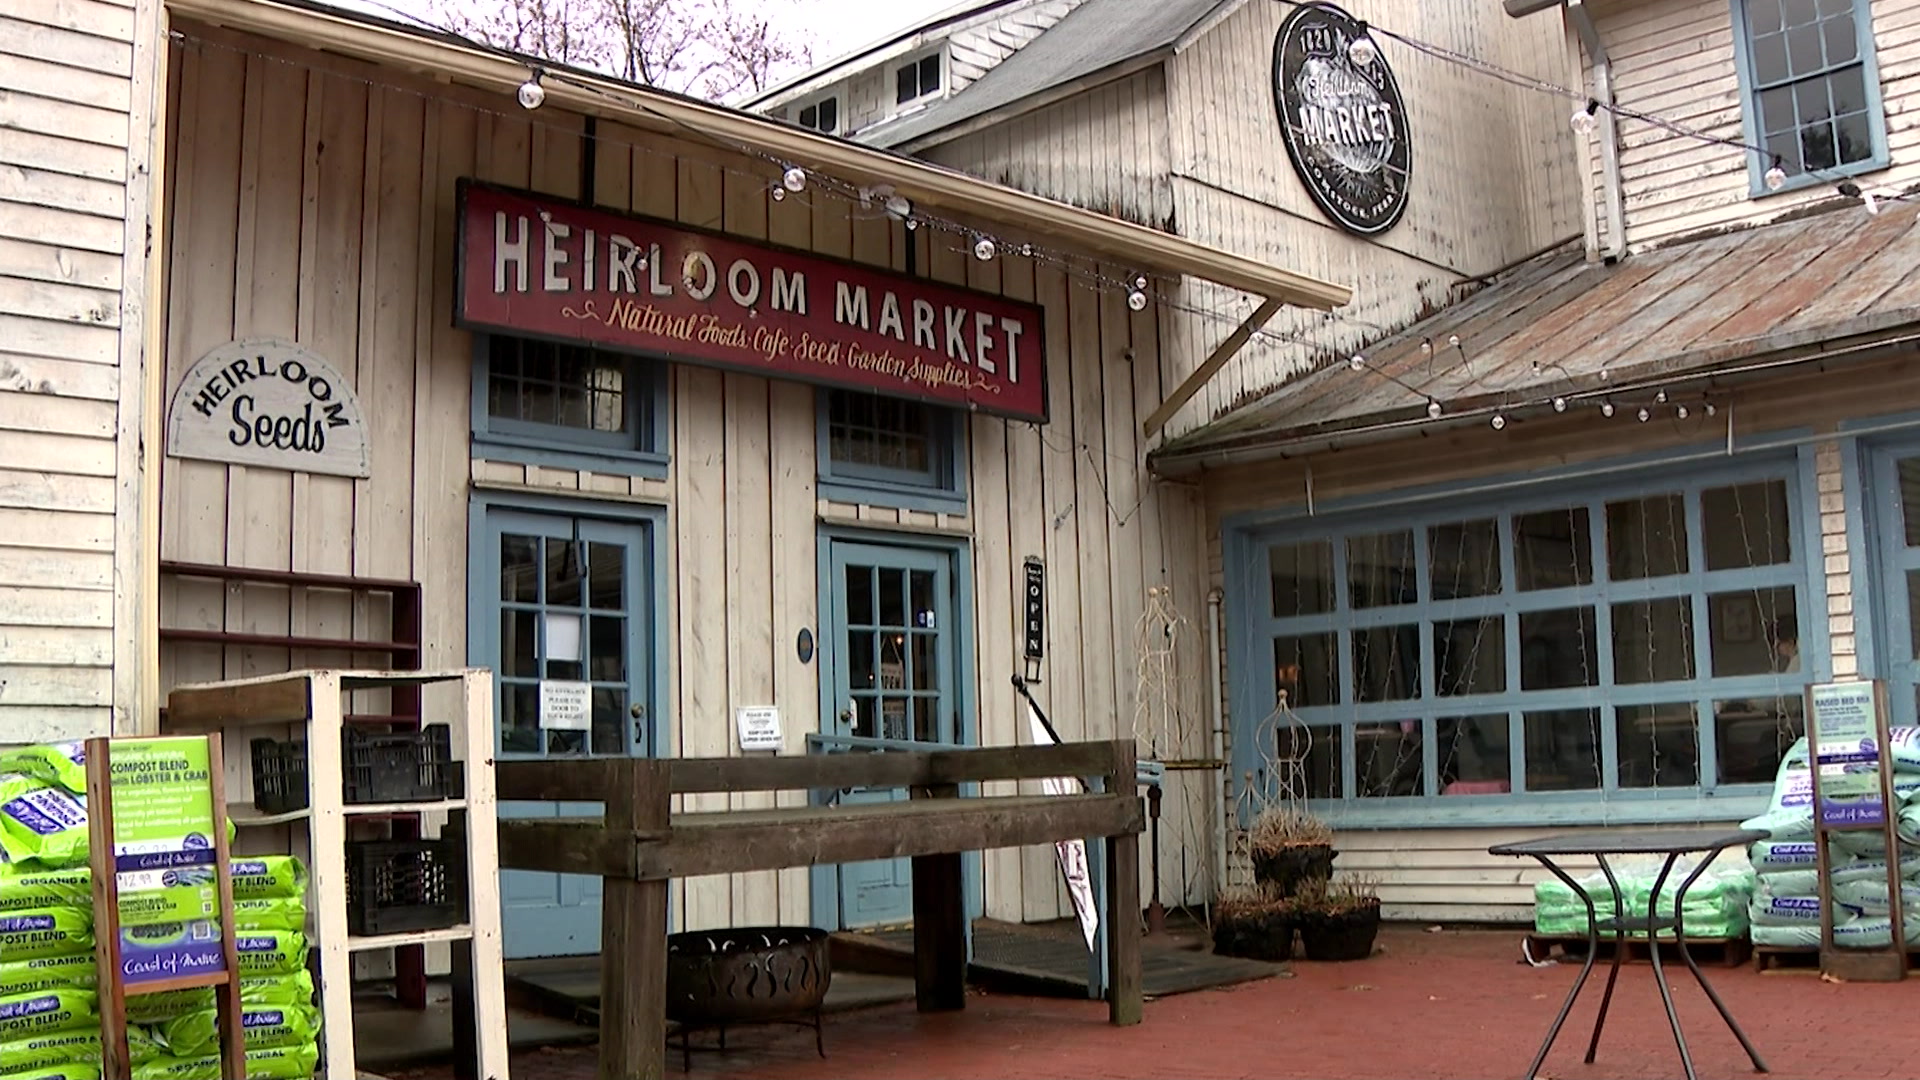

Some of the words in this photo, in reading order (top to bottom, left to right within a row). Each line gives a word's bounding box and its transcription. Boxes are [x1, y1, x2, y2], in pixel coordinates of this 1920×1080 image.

[1299, 100, 1395, 146] MARKET
[494, 210, 807, 315] HEIRLOOM
[835, 280, 1024, 384] MARKET
[604, 297, 697, 341] Natural
[192, 355, 350, 429] HEIRLOOM
[229, 394, 325, 453] Seeds
[1029, 585, 1040, 650] OPEN
[110, 761, 157, 774] COMPOST
[159, 760, 190, 771] BLEND
[131, 772, 171, 785] LOBSTER
[174, 772, 181, 782] &
[183, 769, 208, 781] CRAB
[245, 877, 277, 886] BLEND
[31, 931, 67, 942] BLEND
[123, 953, 161, 976] Coast
[162, 952, 177, 974] of
[179, 952, 220, 968] Maine
[255, 952, 287, 962] BLEND
[35, 1011, 72, 1026] BLEND
[260, 1026, 294, 1037] BLEND
